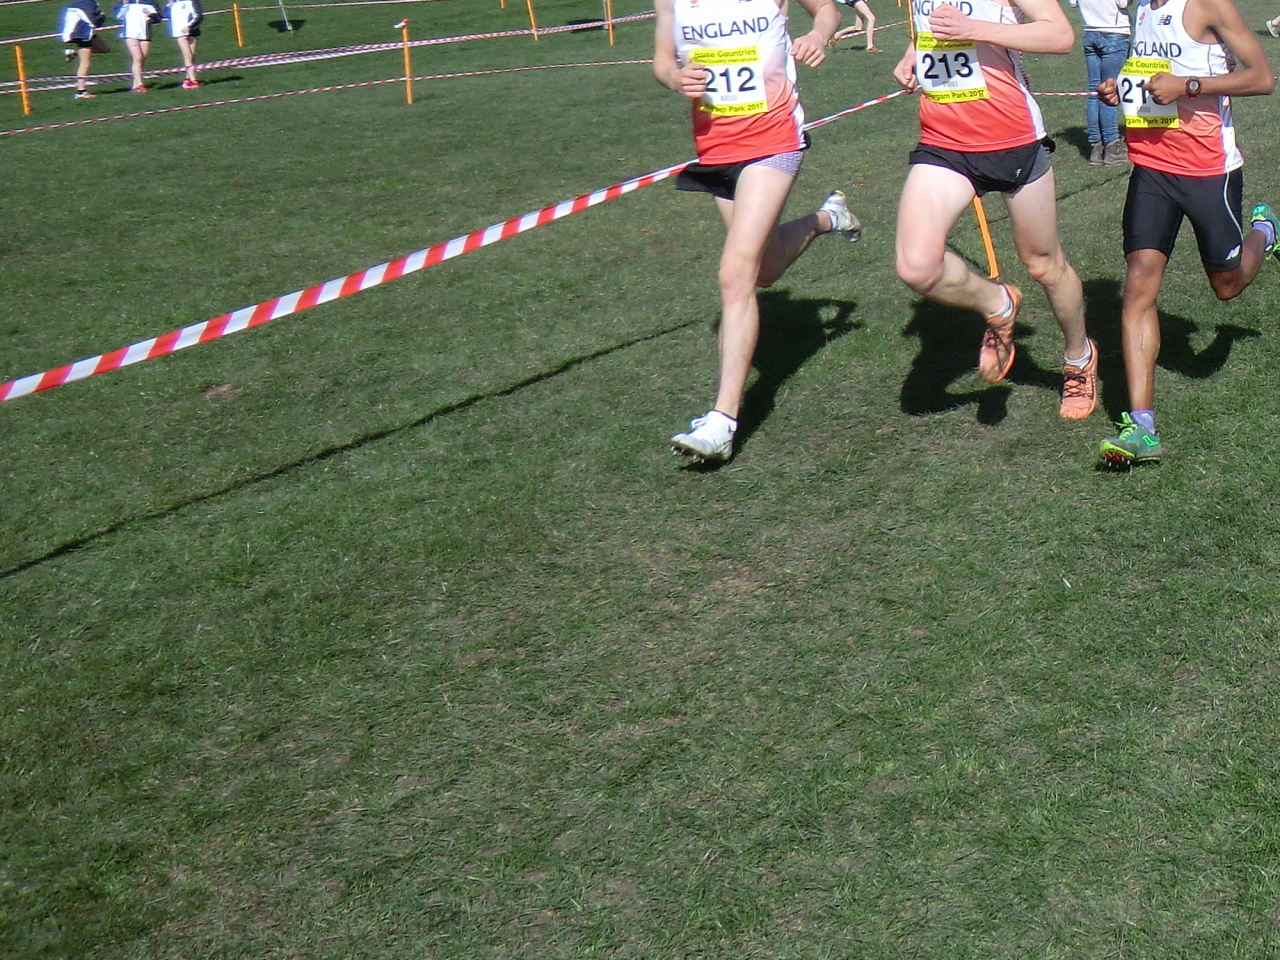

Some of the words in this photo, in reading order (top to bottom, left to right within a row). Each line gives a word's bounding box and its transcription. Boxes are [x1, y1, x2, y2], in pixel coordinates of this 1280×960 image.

[911, 0, 973, 17] NGLD
[682, 16, 769, 41] ENGLAND
[717, 48, 757, 58] Countries
[1133, 40, 1182, 58] GLAND
[922, 51, 974, 79] 213
[1135, 60, 1170, 69] Countries
[703, 66, 757, 93] 212
[951, 91, 968, 99] Park
[728, 105, 746, 113] Park
[747, 102, 764, 111] 2017
[1142, 117, 1159, 125] Park
[1160, 117, 1176, 125] 2017
